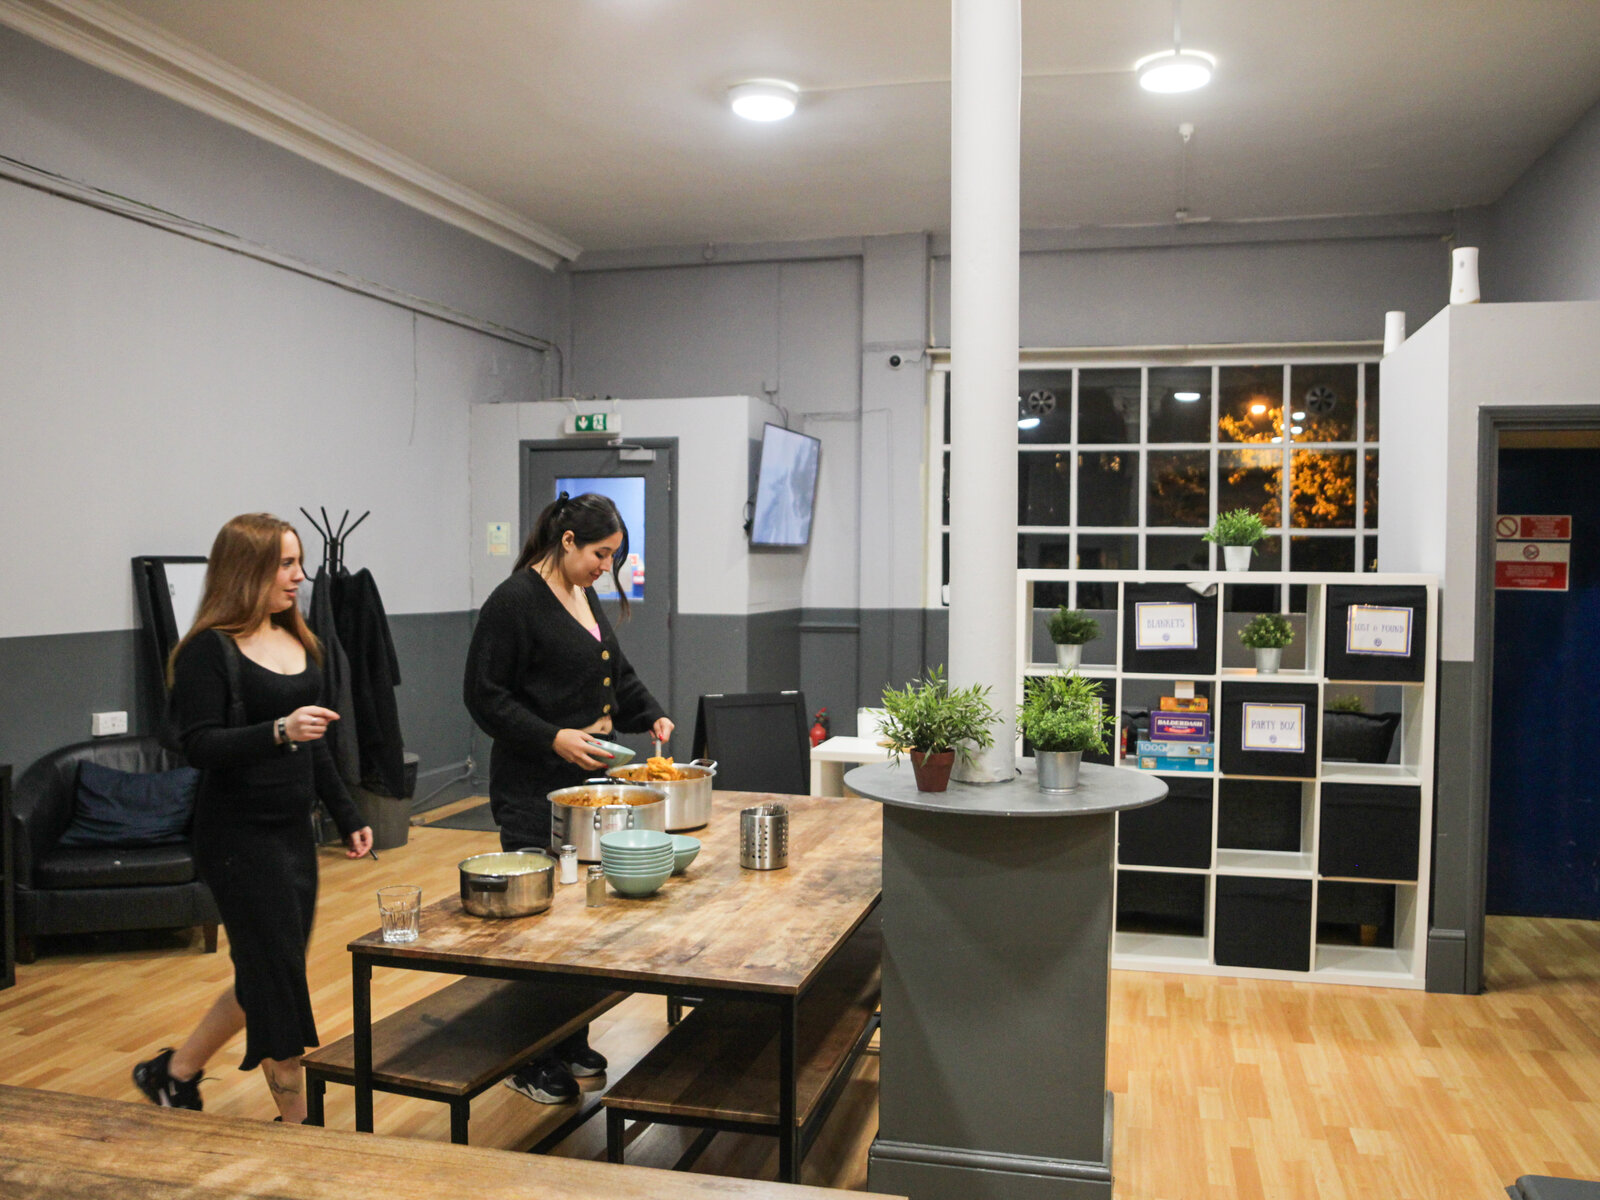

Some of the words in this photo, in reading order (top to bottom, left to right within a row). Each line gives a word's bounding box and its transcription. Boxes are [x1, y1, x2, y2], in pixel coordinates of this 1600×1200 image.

[1157, 719, 1203, 727] BALDERDASH
[1251, 719, 1276, 730] PARTY
[1280, 720, 1296, 730] BOX
